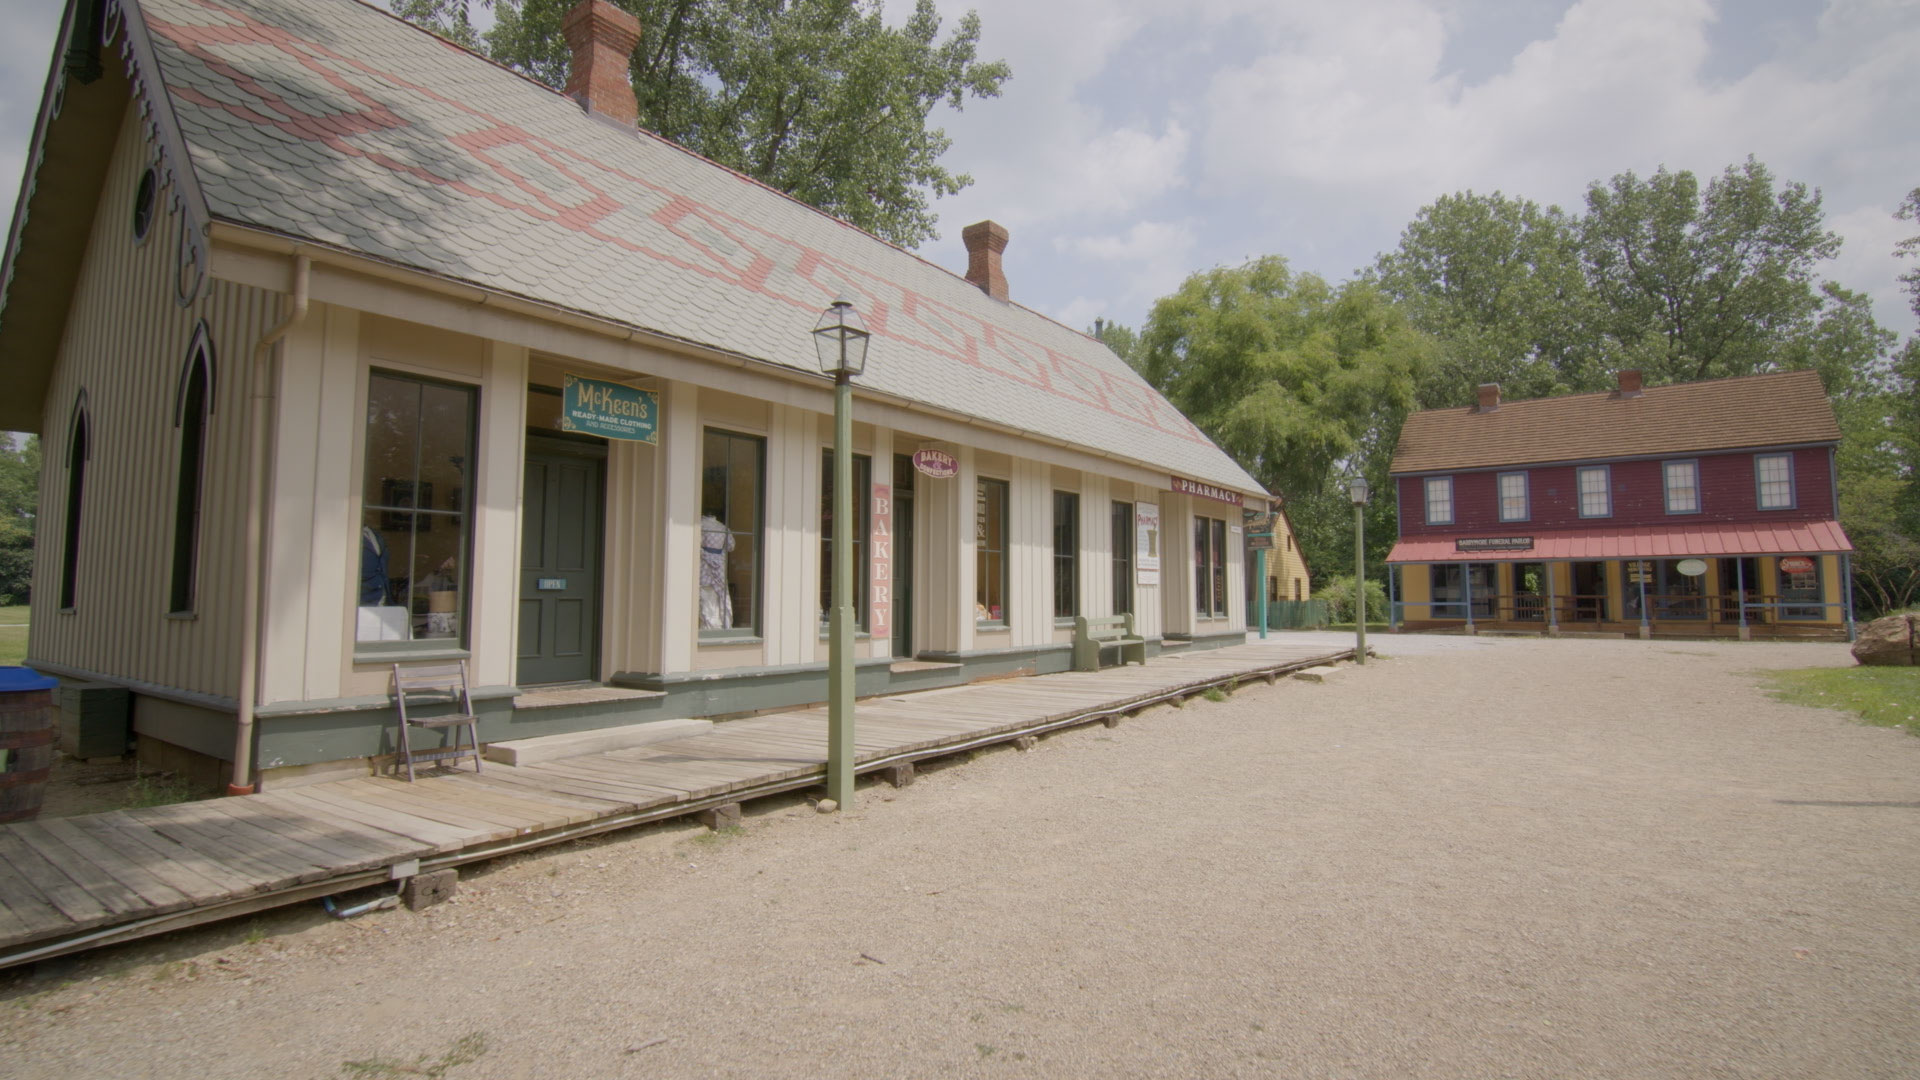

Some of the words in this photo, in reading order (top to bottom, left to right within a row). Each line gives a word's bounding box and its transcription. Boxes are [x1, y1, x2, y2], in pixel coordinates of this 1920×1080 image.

[577, 382, 648, 419] McKeen's
[572, 410, 619, 425] READY-MADE
[620, 418, 652, 430] CLOTHING
[586, 420, 599, 428] AND
[599, 422, 636, 434] ACCESSORIES
[920, 451, 953, 466] BAKERY
[920, 462, 953, 476] CONFECTIONS
[1182, 480, 1237, 503] PHARMACY
[873, 498, 889, 626] BAKERY
